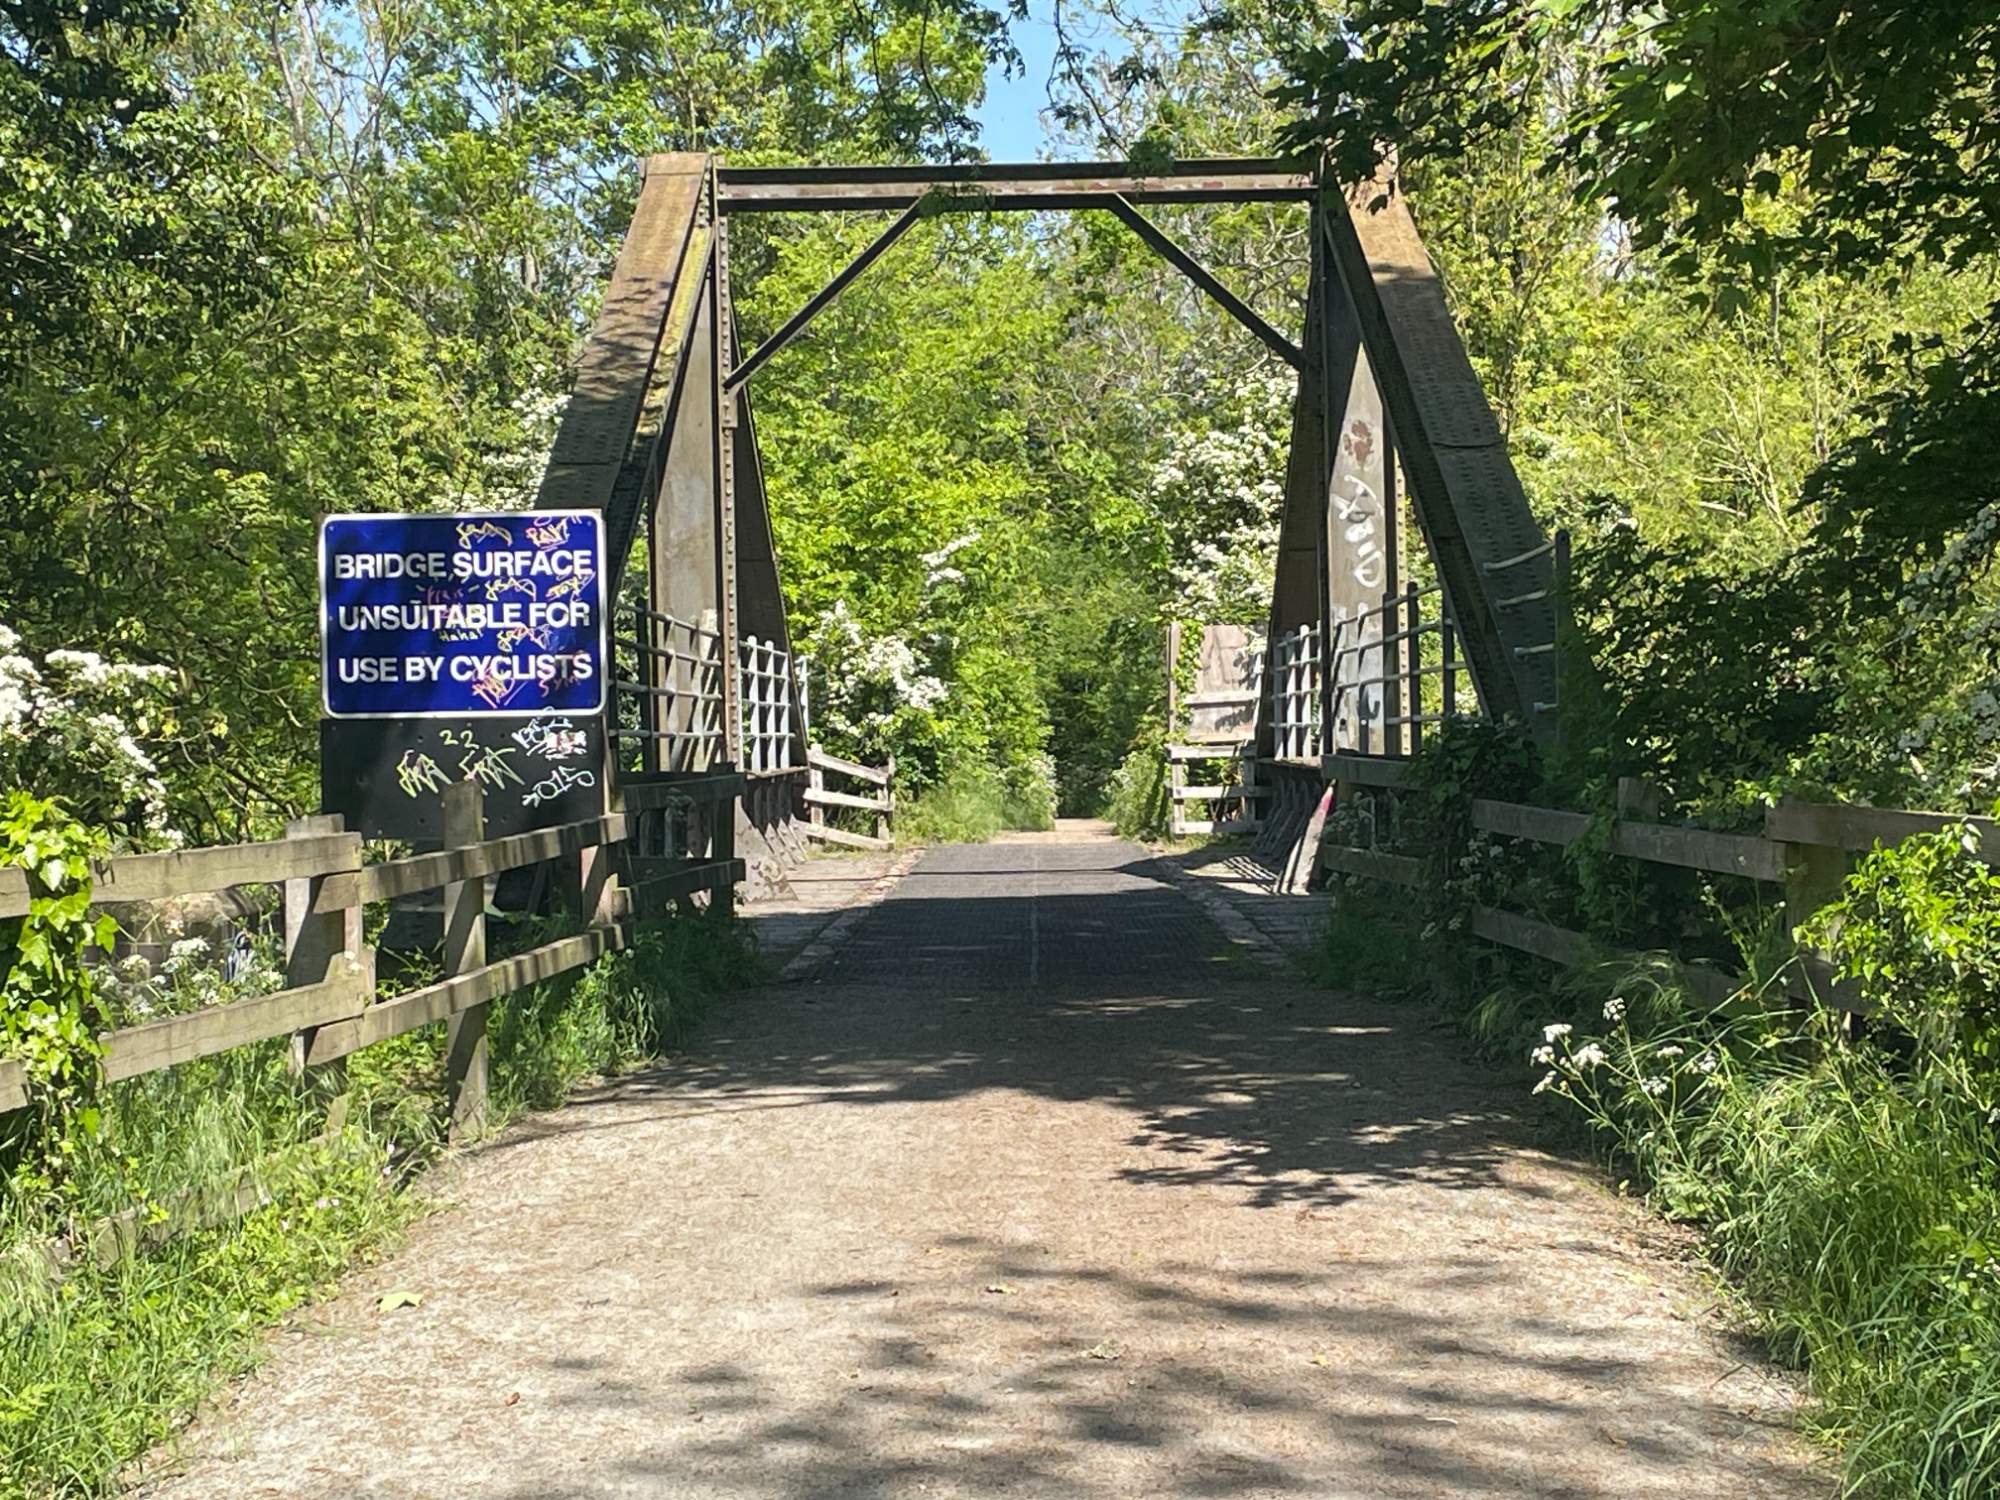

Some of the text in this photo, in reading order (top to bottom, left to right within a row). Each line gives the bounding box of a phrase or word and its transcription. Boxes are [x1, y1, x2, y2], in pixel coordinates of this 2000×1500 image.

[335, 550, 593, 579] BRIDGE SURFACE
[338, 601, 591, 631] UNSUITABLE FOR
[338, 653, 593, 683] USE BY CYCLISTS
